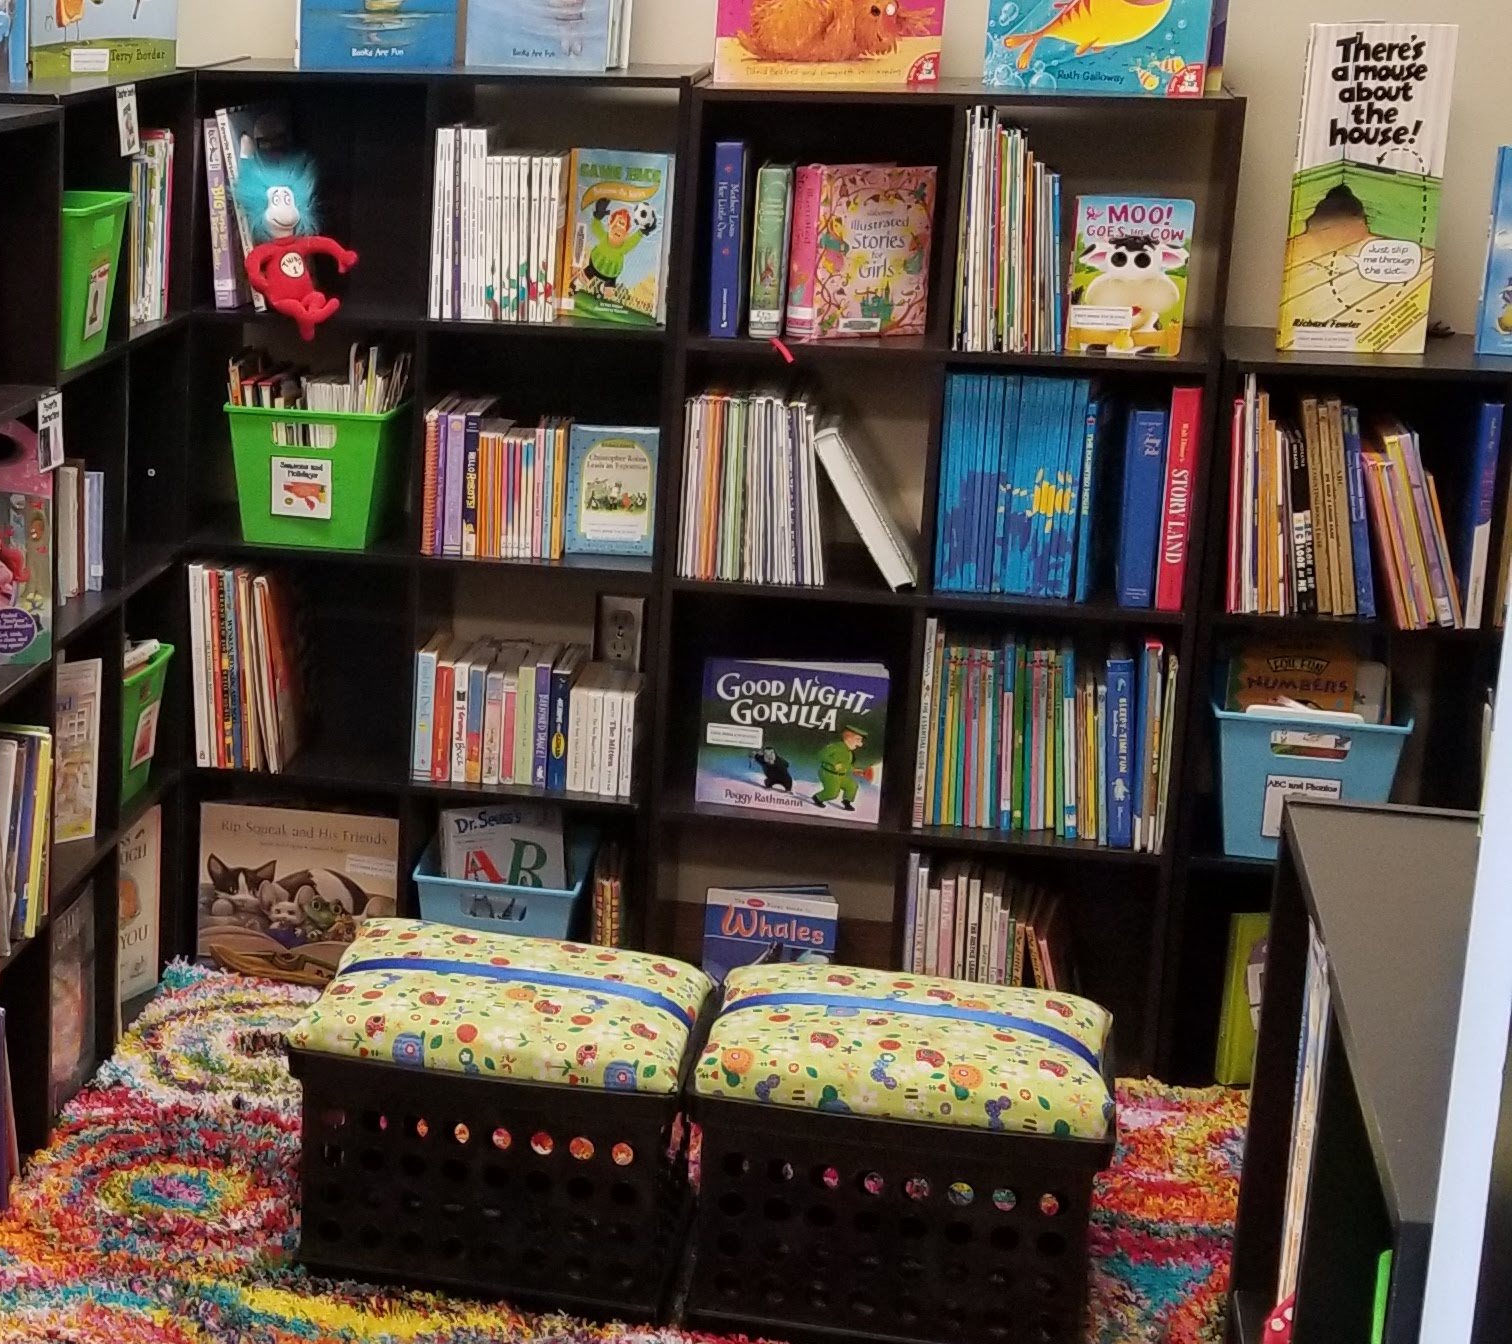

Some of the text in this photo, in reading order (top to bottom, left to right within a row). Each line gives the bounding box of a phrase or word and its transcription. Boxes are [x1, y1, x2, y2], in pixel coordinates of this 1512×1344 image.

[110, 48, 133, 64] Terry
[136, 47, 166, 61] Border
[391, 47, 405, 56] Fun
[1336, 31, 1426, 64] There's
[1057, 69, 1125, 85] Ruth Galloway
[1331, 62, 1428, 82] a mouse
[1338, 82, 1414, 103] about
[1351, 102, 1399, 125] the
[1329, 118, 1424, 147] house!
[210, 184, 226, 211] BIG
[1107, 204, 1175, 226] MOO!
[851, 233, 906, 250] Stories
[1086, 225, 1185, 241] GOES COW
[1391, 245, 1409, 256] slip
[291, 266, 299, 276] 1
[858, 258, 896, 279] Girls
[1164, 468, 1189, 564] STORY LAND
[1295, 545, 1308, 593] LOOK ME
[716, 672, 785, 700] GOOD
[1247, 675, 1349, 694] NUMBERS
[536, 694, 549, 758] BARNYARD DANCE!
[730, 699, 838, 732] GORILLA
[607, 720, 616, 769] The Mitten
[1267, 779, 1338, 793] ABC and Phonics
[724, 788, 804, 807] Peggy Rathmann
[221, 820, 241, 832] Rip
[292, 826, 314, 839] and
[319, 828, 339, 840] His
[464, 847, 506, 884] A
[721, 903, 825, 945] Whales
[119, 923, 149, 951] YOU
